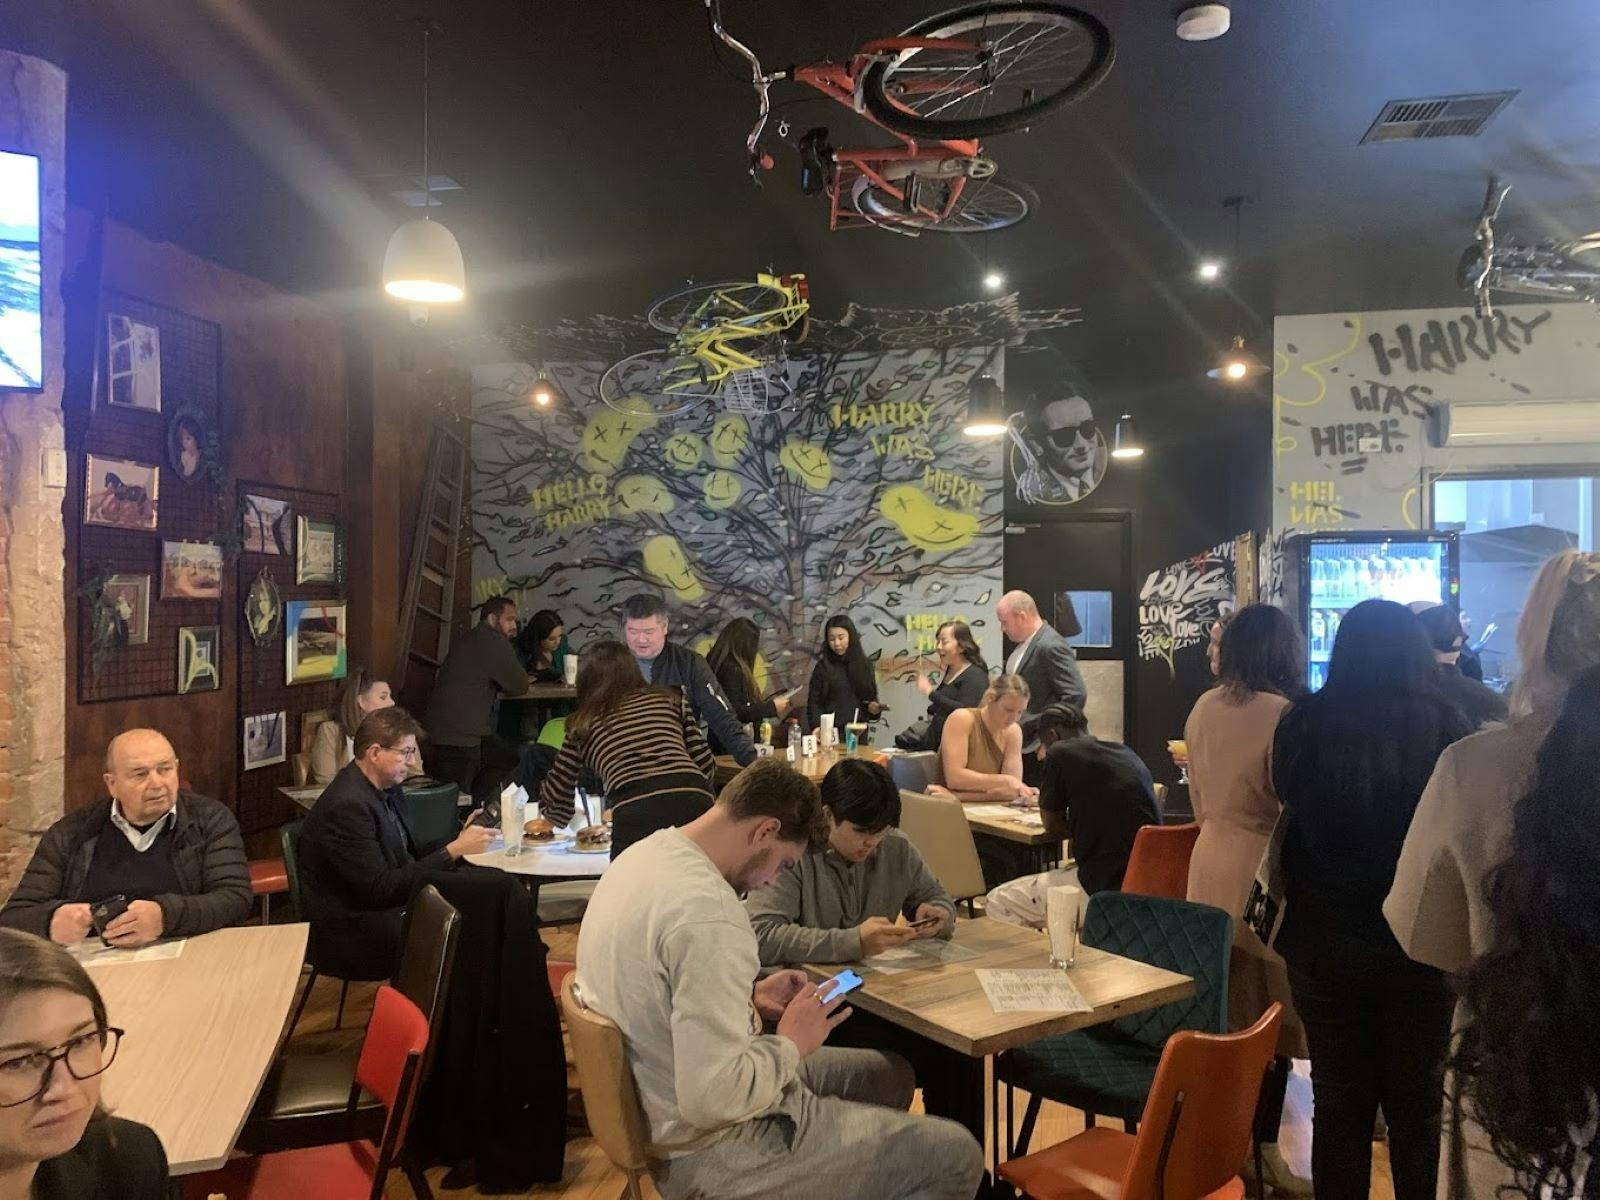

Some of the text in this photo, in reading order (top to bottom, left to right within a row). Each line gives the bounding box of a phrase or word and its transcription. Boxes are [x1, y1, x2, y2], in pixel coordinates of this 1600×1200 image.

[1369, 310, 1552, 375] HARRY
[832, 402, 935, 429] HARRY
[1352, 380, 1434, 420] WAS
[871, 433, 936, 461] WAS
[532, 473, 608, 512] HELLO
[545, 500, 609, 530] HARRY
[1140, 567, 1236, 604] LOVE
